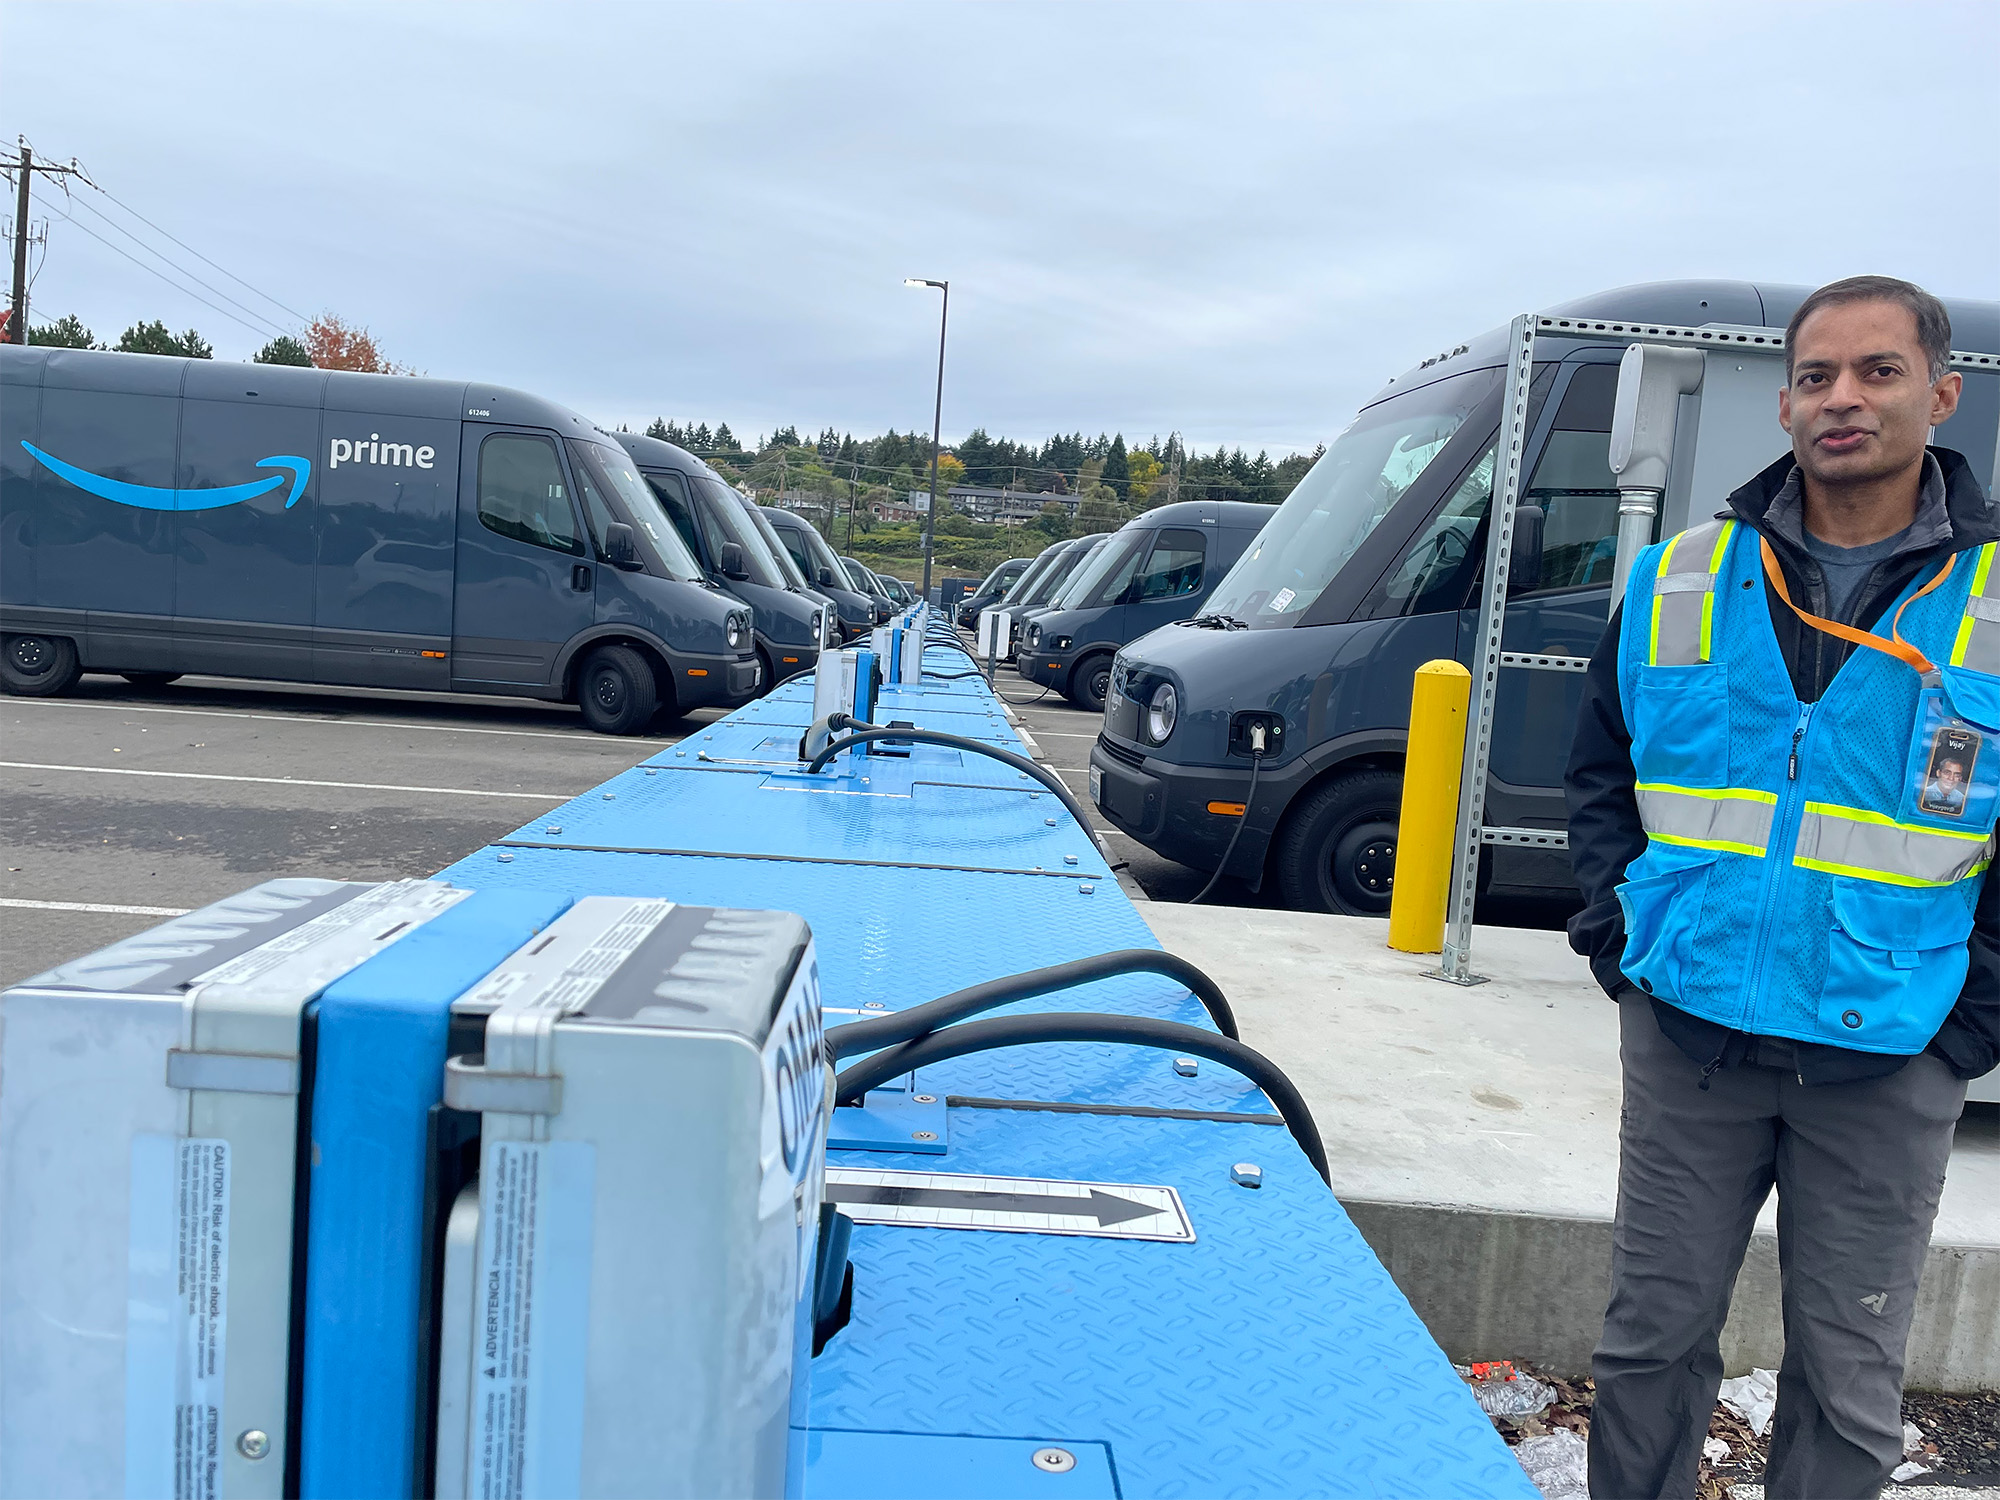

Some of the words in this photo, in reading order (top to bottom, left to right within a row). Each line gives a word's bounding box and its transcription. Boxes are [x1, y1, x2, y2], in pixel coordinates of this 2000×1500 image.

[329, 433, 435, 469] prime
[1949, 739, 1965, 750] Vijay
[213, 1146, 224, 1201] CAUTION:
[213, 1204, 223, 1227] Risk
[212, 1231, 221, 1242] of
[210, 1244, 221, 1282] electric
[210, 1286, 220, 1320] shock.
[486, 1271, 500, 1359] ADVERTENCIA
